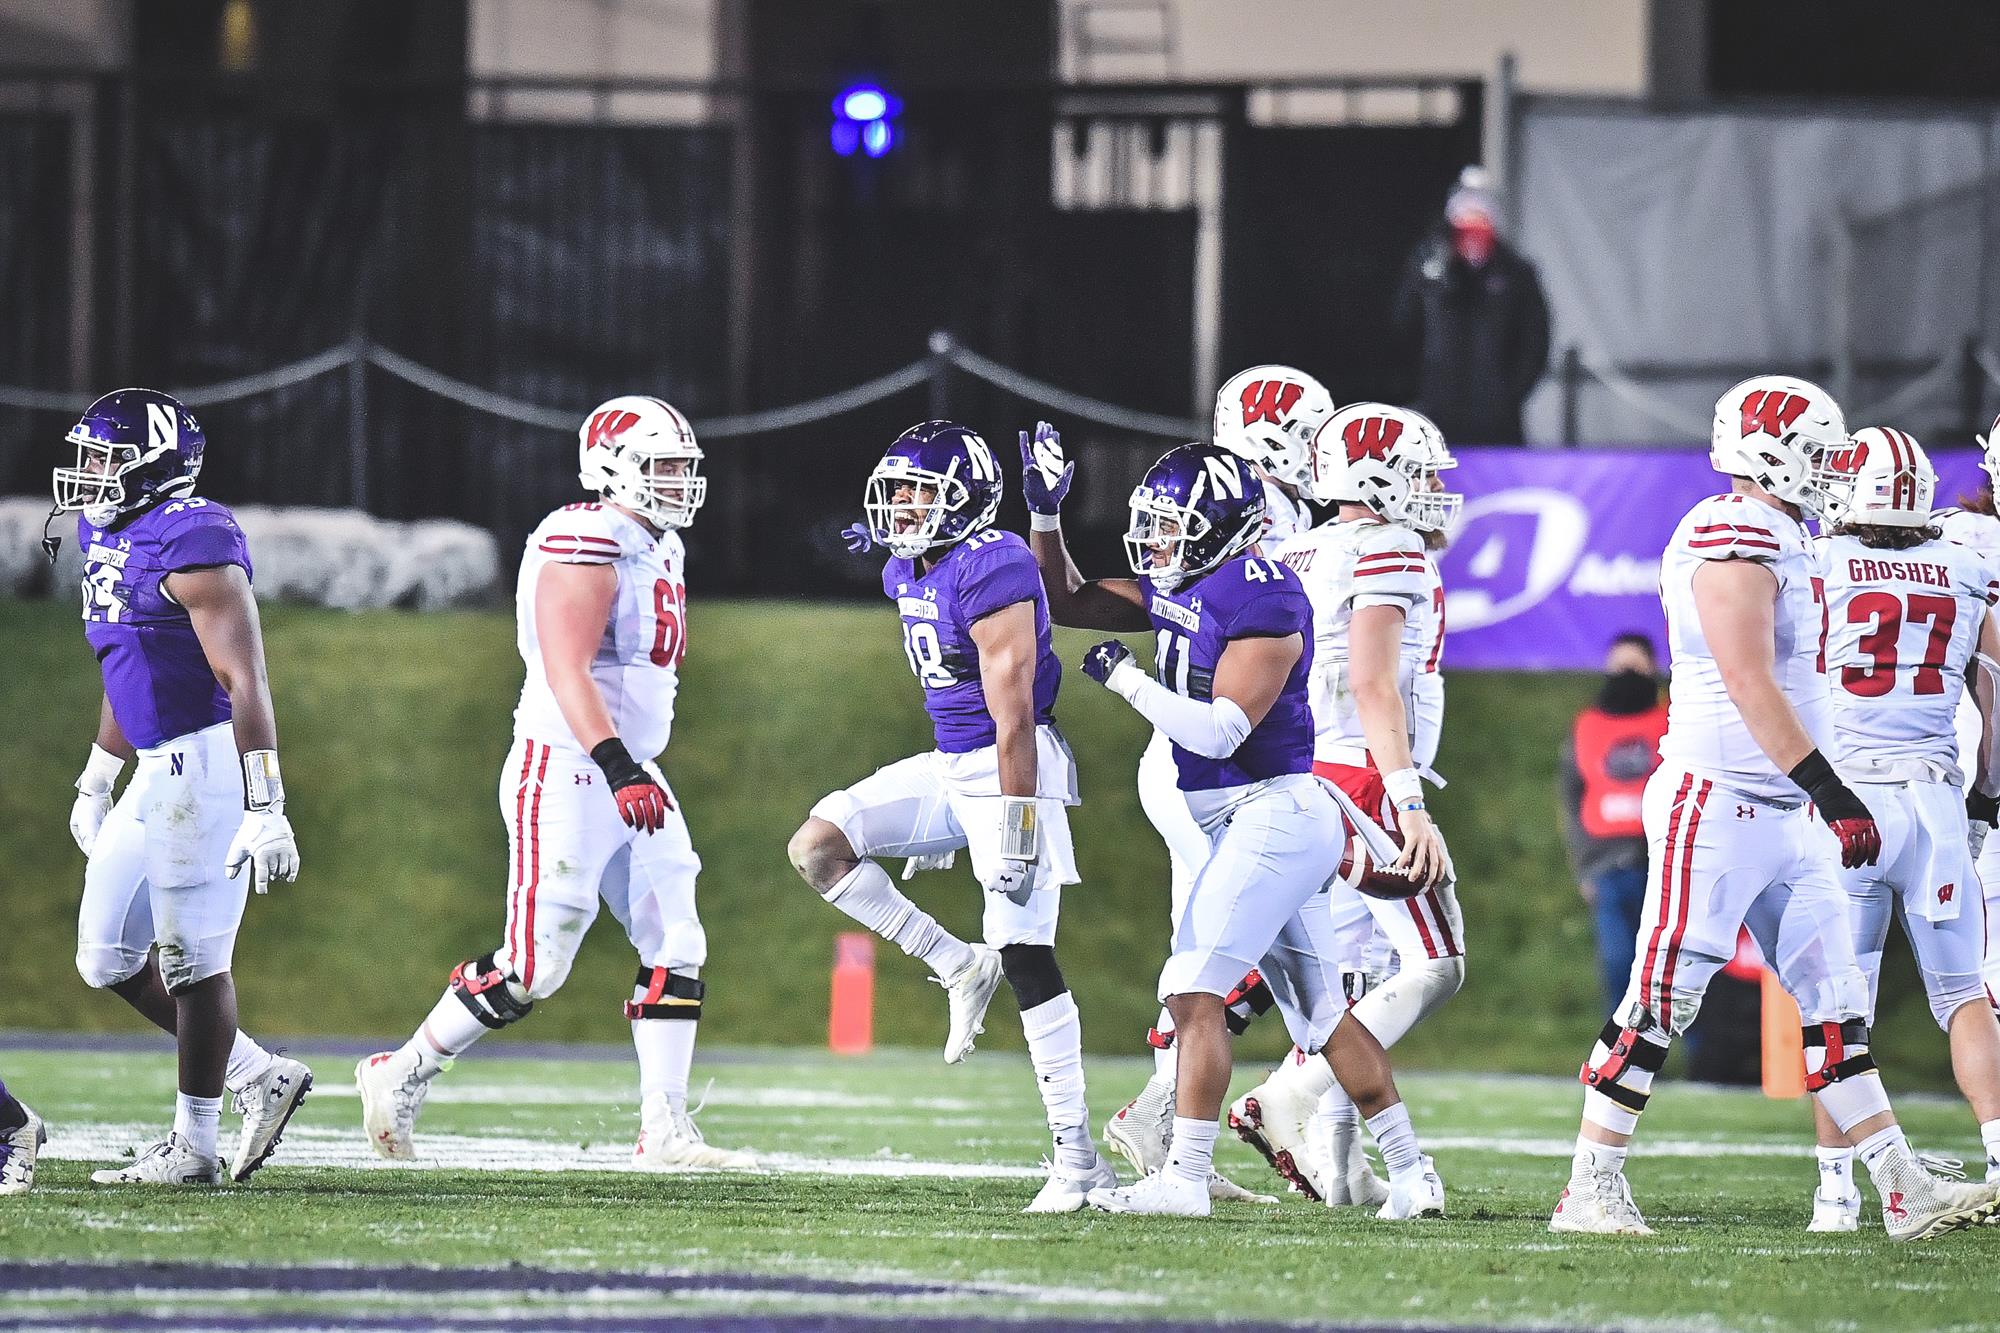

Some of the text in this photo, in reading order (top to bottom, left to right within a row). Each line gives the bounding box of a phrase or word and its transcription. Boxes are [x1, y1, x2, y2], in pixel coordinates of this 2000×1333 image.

[146, 403, 178, 450] N
[1240, 380, 1304, 428] W
[1739, 389, 1811, 438] W
[586, 410, 641, 452] W
[1342, 417, 1404, 467] W
[961, 434, 995, 481] N
[1203, 455, 1243, 500] N
[1245, 558, 1285, 583] 41
[1848, 558, 1951, 588] GROSHEK
[1841, 591, 1957, 698] 37
[170, 752, 184, 776] N
[1937, 883, 1954, 905] W
